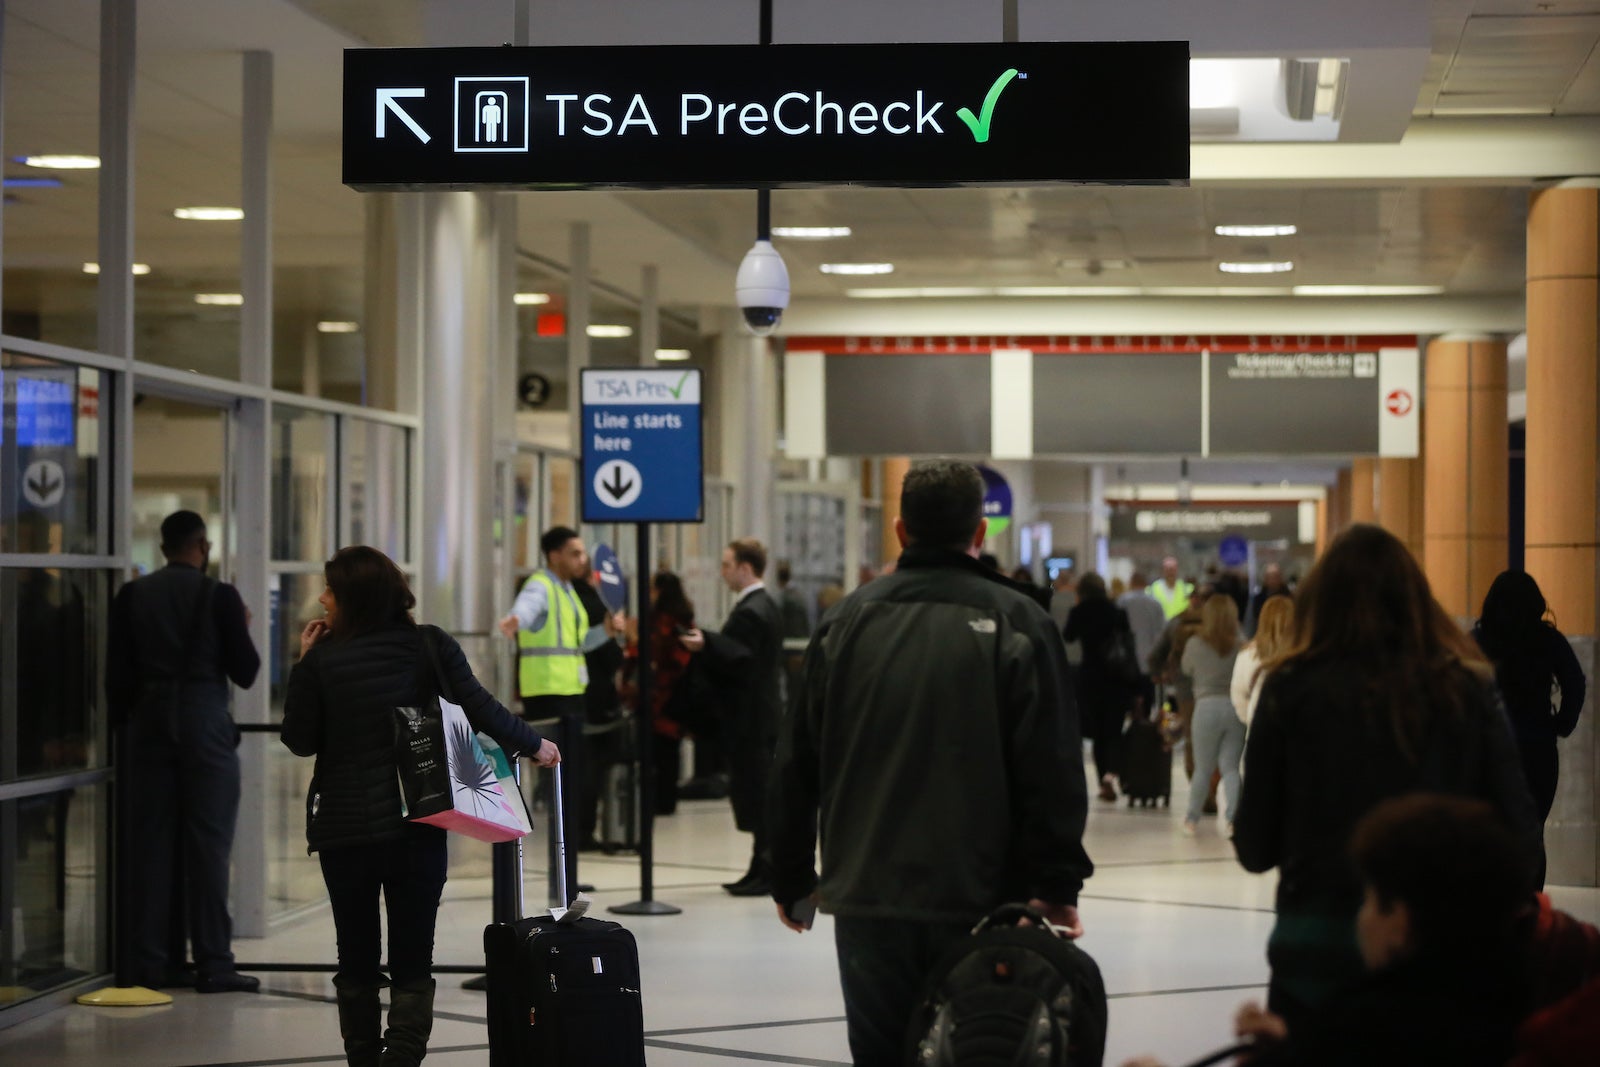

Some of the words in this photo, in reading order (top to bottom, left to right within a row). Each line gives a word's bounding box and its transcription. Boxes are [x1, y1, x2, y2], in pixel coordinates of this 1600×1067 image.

[545, 93, 659, 137] TSA
[681, 90, 945, 135] PreCheck
[527, 379, 543, 401] 2
[595, 379, 631, 398] TSA
[636, 379, 667, 398] Pre
[594, 412, 629, 429] Line
[634, 413, 682, 429] starts
[594, 433, 632, 451] here
[410, 737, 430, 746] DALLAS
